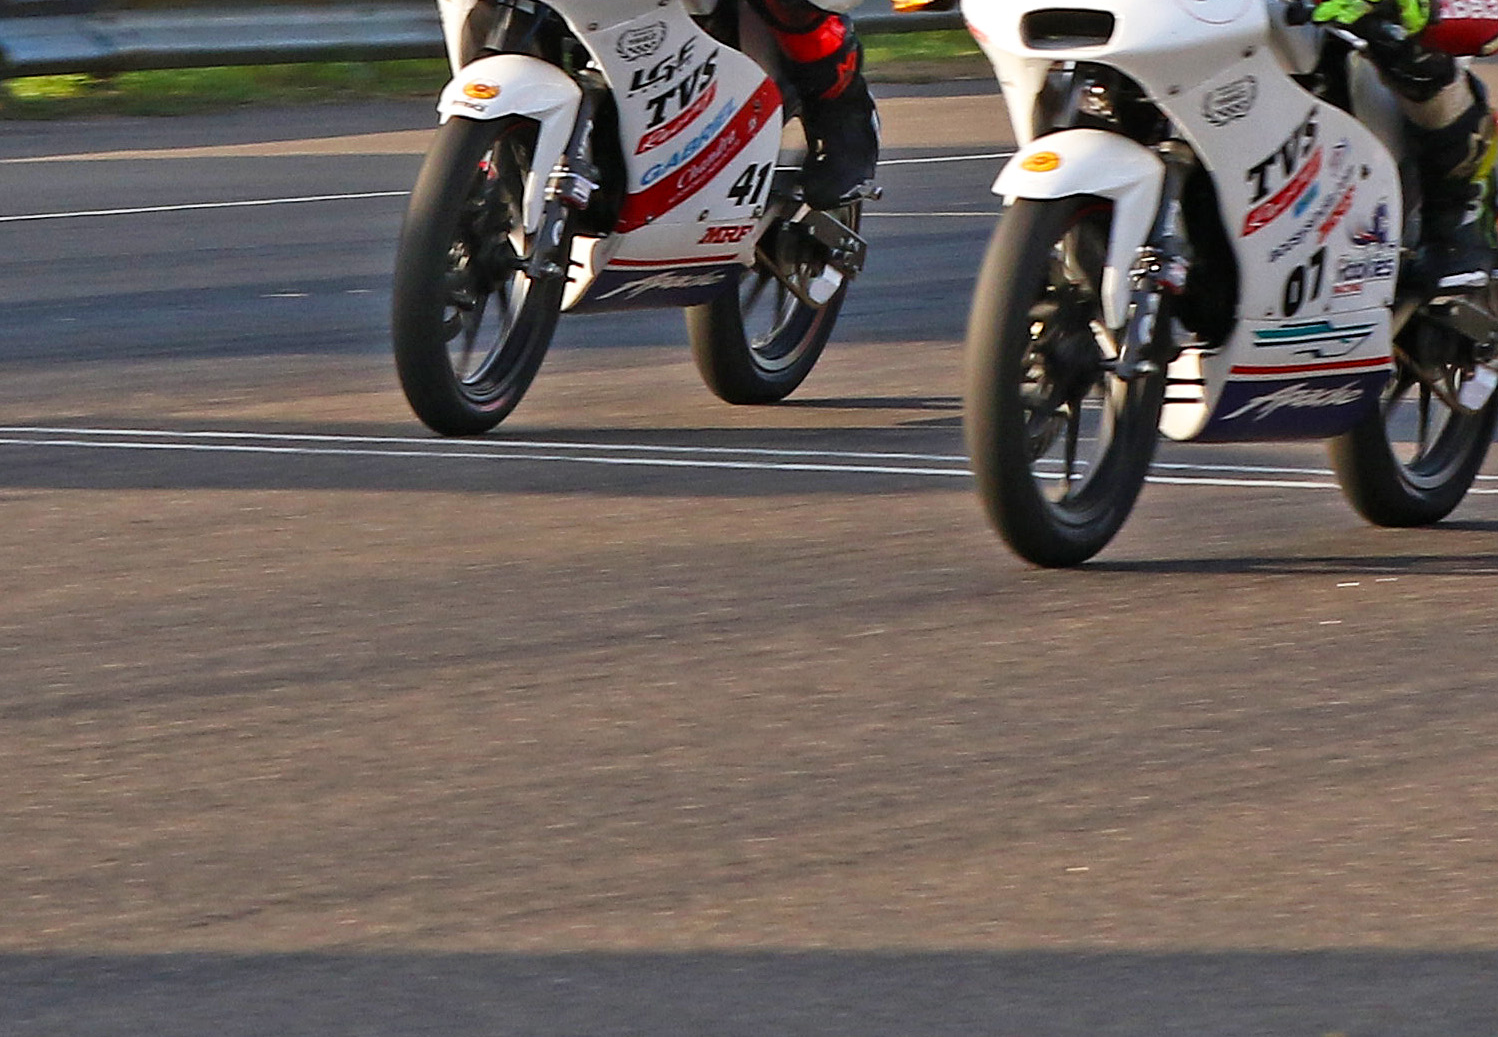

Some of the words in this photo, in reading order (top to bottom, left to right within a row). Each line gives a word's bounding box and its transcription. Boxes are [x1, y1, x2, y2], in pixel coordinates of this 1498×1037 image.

[646, 47, 720, 130] TVS
[727, 162, 772, 206] 41
[1246, 106, 1318, 204] TVS
[697, 225, 753, 244] MRF
[1283, 246, 1326, 318] 07
